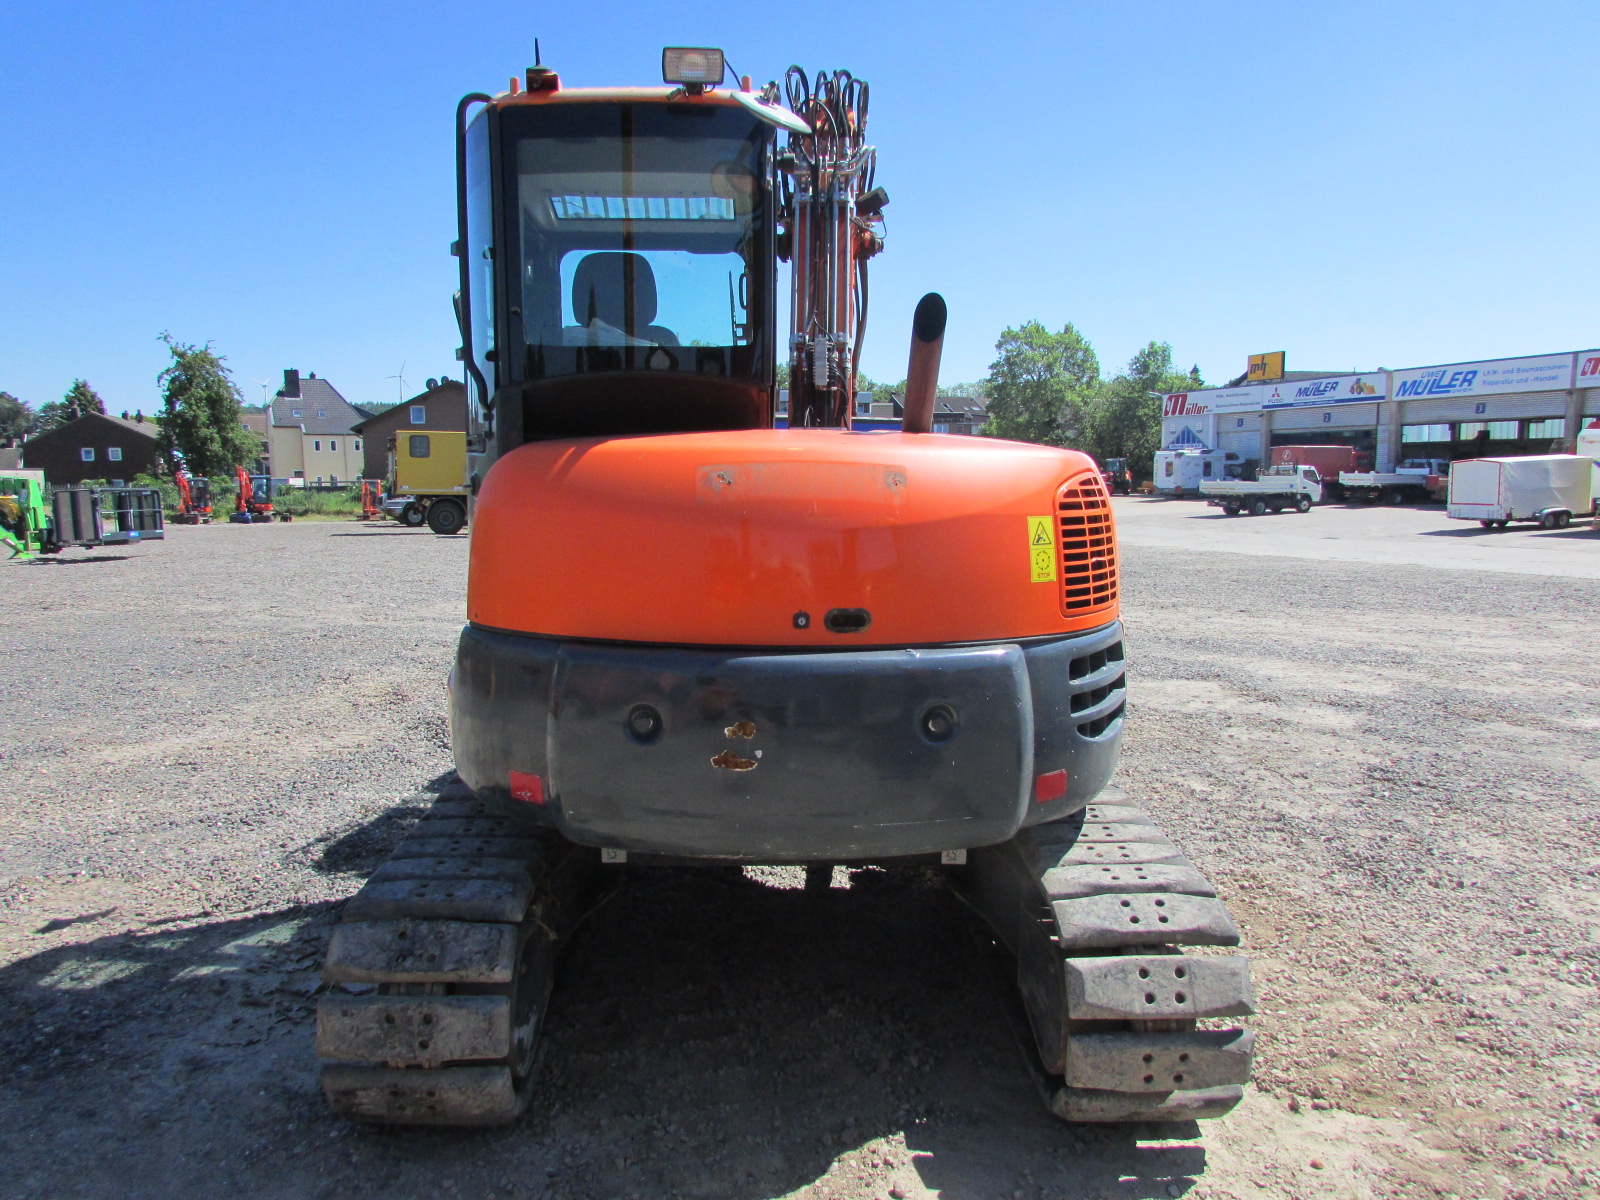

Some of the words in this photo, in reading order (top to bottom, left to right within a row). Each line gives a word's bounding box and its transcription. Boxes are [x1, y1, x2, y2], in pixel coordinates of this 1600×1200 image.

[1421, 370, 1442, 379] UWE
[1483, 369, 1500, 377] LKW-
[1516, 364, 1569, 374] Baumaschinen-
[1482, 378, 1514, 386] Reparatur
[1295, 381, 1339, 398] MÜLLER
